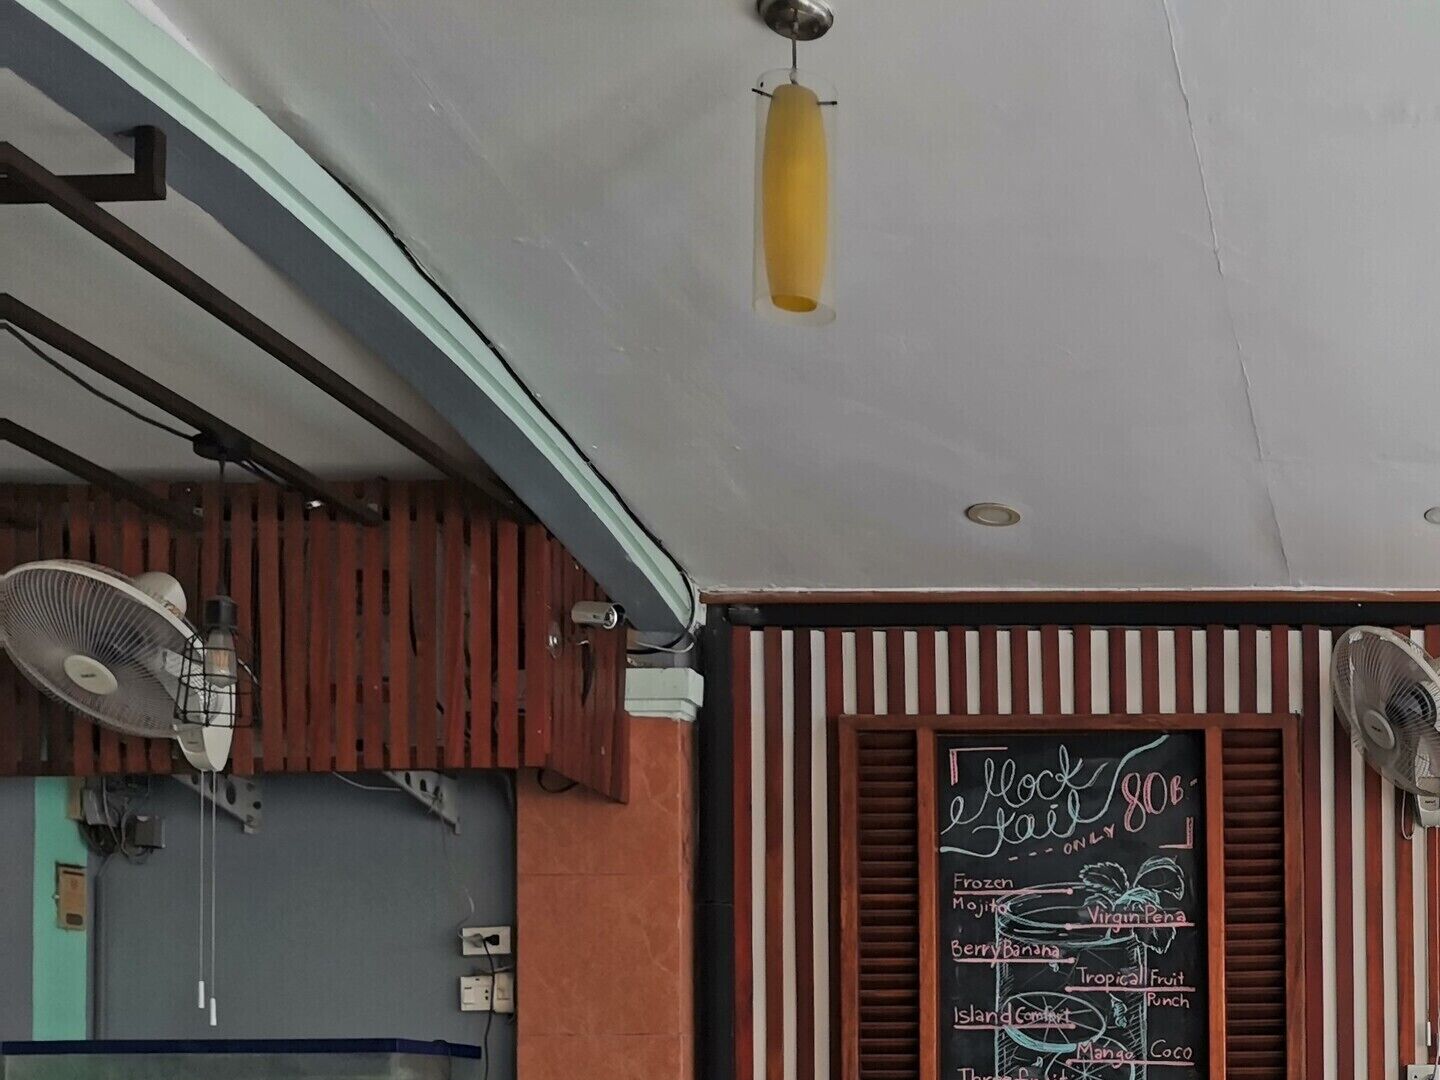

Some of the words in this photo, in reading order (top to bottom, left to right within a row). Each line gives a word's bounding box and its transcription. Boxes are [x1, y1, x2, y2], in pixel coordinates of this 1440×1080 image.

[1063, 823, 1116, 855] ONLY
[953, 873, 1014, 889] Frozen
[952, 897, 1009, 918] Mojito
[1087, 905, 1140, 932] Virgin
[951, 940, 999, 968] Berry
[1003, 941, 1060, 957] Banana
[1076, 967, 1144, 992] Tropical
[1150, 969, 1185, 985] Fruit
[954, 1003, 1012, 1024] Island
[1015, 1006, 1070, 1024] Comfort
[1147, 993, 1190, 1009] Punch
[1076, 1042, 1135, 1069] Mango
[1150, 1040, 1193, 1059] Coco
